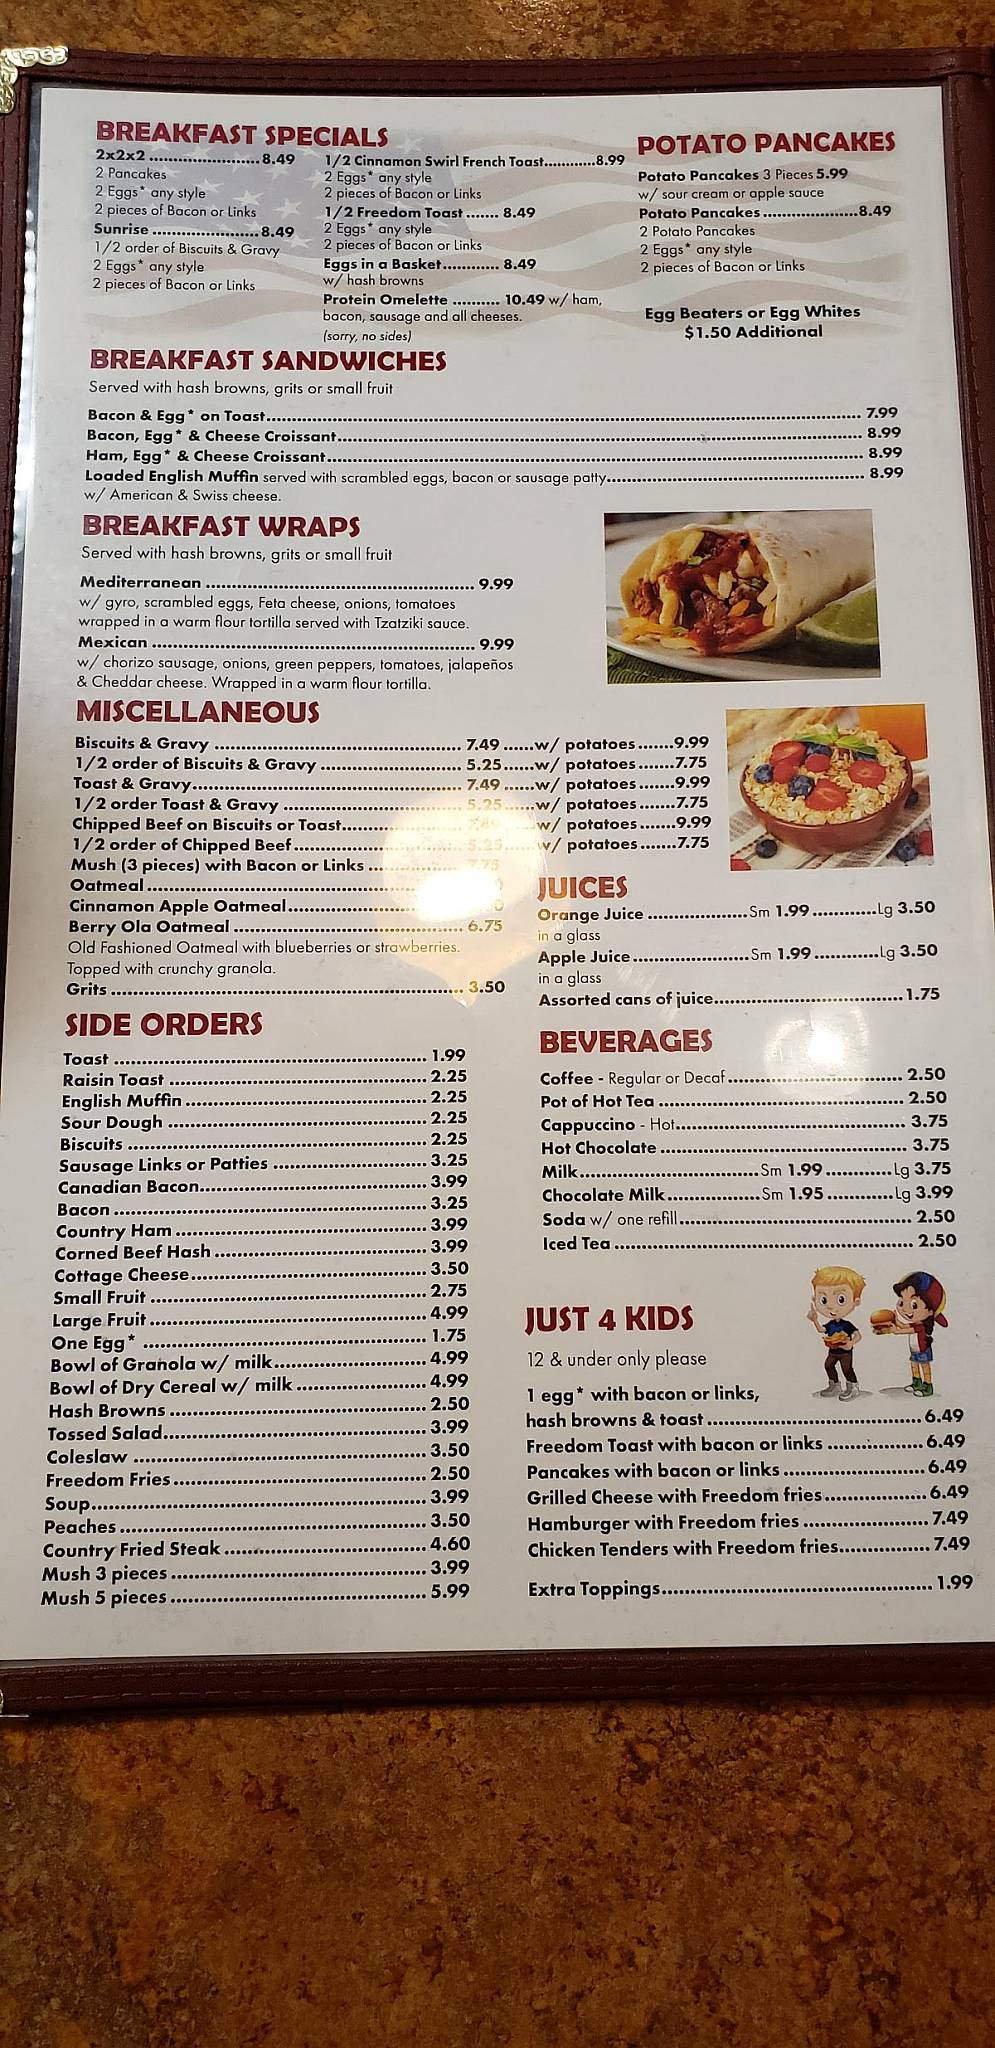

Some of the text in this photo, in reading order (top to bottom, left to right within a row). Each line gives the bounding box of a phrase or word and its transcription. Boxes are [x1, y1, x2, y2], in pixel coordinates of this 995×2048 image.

[97, 121, 388, 147] BREAKFAST SPECIALS
[638, 131, 895, 155] POTATO PANCAKES
[96, 149, 295, 165] 2x2x2 8.49
[96, 166, 167, 180] 2 Pancakes
[638, 168, 848, 182] Potato Pancakes 3 Pieces 5.99
[95, 185, 103, 196] 2
[151, 190, 174, 201] any
[177, 186, 206, 202] style
[638, 187, 658, 202] w/
[662, 191, 688, 199] sour
[691, 191, 729, 199] cream
[749, 185, 785, 201] apple
[789, 190, 824, 198] sauce
[325, 205, 535, 220] 1/2 Freedom Toast 8.49
[94, 223, 294, 237] Sunrise 8.49
[96, 240, 280, 259] 1/2 order of Biscuits & Gravy
[324, 293, 602, 307] Protein Omelette 10.49 w/ ham,
[323, 309, 522, 325] bacon, sausage and all cheeses.
[645, 304, 861, 323] Egg Beaters or Egg Whites
[323, 329, 358, 344] (sorry,
[379, 330, 412, 343] sides)
[685, 324, 823, 340] $1.50 Additional
[90, 349, 446, 371] BREAKFAST SANDWICHES
[89, 379, 393, 397] Served with hash browns, grits or small fruit
[84, 487, 281, 503] w/ American & Swiss cheese.
[83, 515, 360, 538] BREAKFAST WRAPS
[80, 575, 513, 590] Mediterranean 9.99
[78, 635, 514, 650] Mexican 9.99
[77, 654, 513, 674] w/ chorizo sausage, onions, green peppers, tomatoes, jalapeños
[77, 700, 319, 724] MISCELLANEOUS
[75, 736, 135, 749] Biscuits
[139, 737, 152, 749] &
[157, 737, 209, 753] Gravy
[467, 739, 500, 751] 7.49
[534, 737, 560, 753] w/
[674, 736, 709, 749] 9.99
[537, 876, 628, 902] JUICES
[538, 901, 935, 924] Orange Juice Sm 1.99 Lg 3.50
[69, 919, 502, 937] Berry Ola Oatmeal 6.75
[65, 1012, 262, 1037] SIDE ORDERS
[540, 1029, 712, 1053] BEVERAGES
[541, 1091, 947, 1108] Pot of Hot Tea 2.50
[61, 1111, 467, 1132] Sour Dough 2.25
[542, 1138, 949, 1155] Hot Chocolate 3.75
[59, 1153, 468, 1176] Sausage Links or Patties 3.25
[56, 1217, 468, 1242] Country Ham 3.99
[544, 1234, 957, 1250] Iced Tea 2.50
[525, 1305, 693, 1336] JUST 4 KIDS
[528, 1349, 707, 1371] 12 & under only please
[49, 1396, 469, 1418] Hash Browns 2.50
[527, 1434, 965, 1453] Freedom Toast with bacon or links 6.49
[528, 1510, 968, 1535] Hamburger with Freedom fries 7.49
[42, 1560, 469, 1585] Mush 3 pieces 3.99
